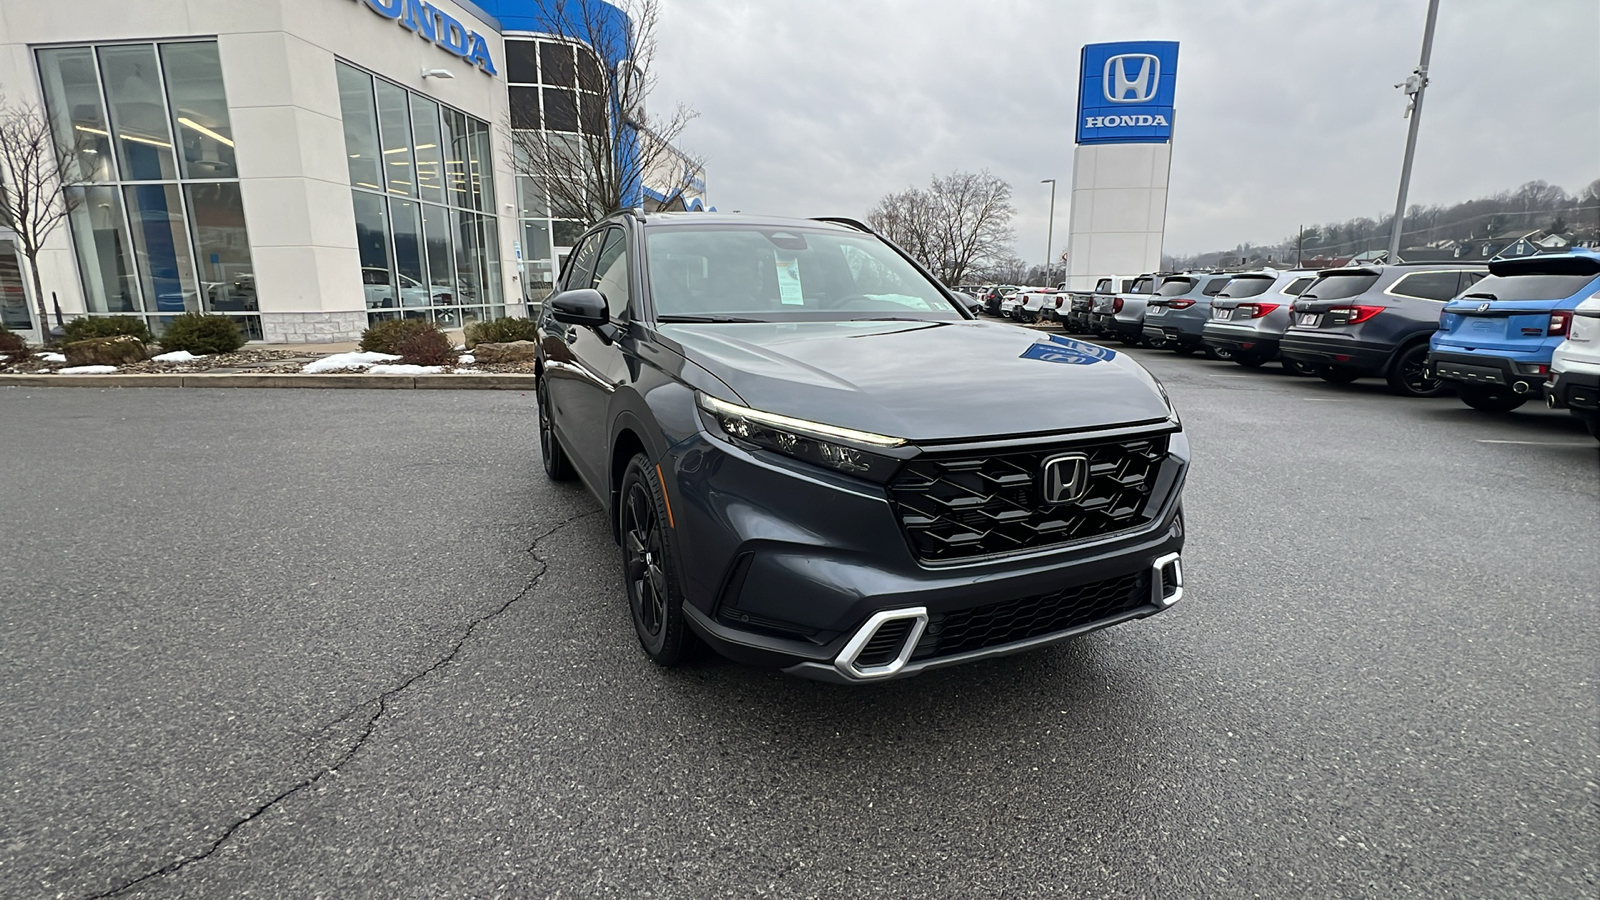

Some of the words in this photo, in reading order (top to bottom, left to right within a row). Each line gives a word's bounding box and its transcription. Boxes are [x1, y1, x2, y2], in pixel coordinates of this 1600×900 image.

[363, 0, 497, 76] NDA
[1113, 55, 1152, 101] H
[1085, 115, 1168, 128] HONDA
